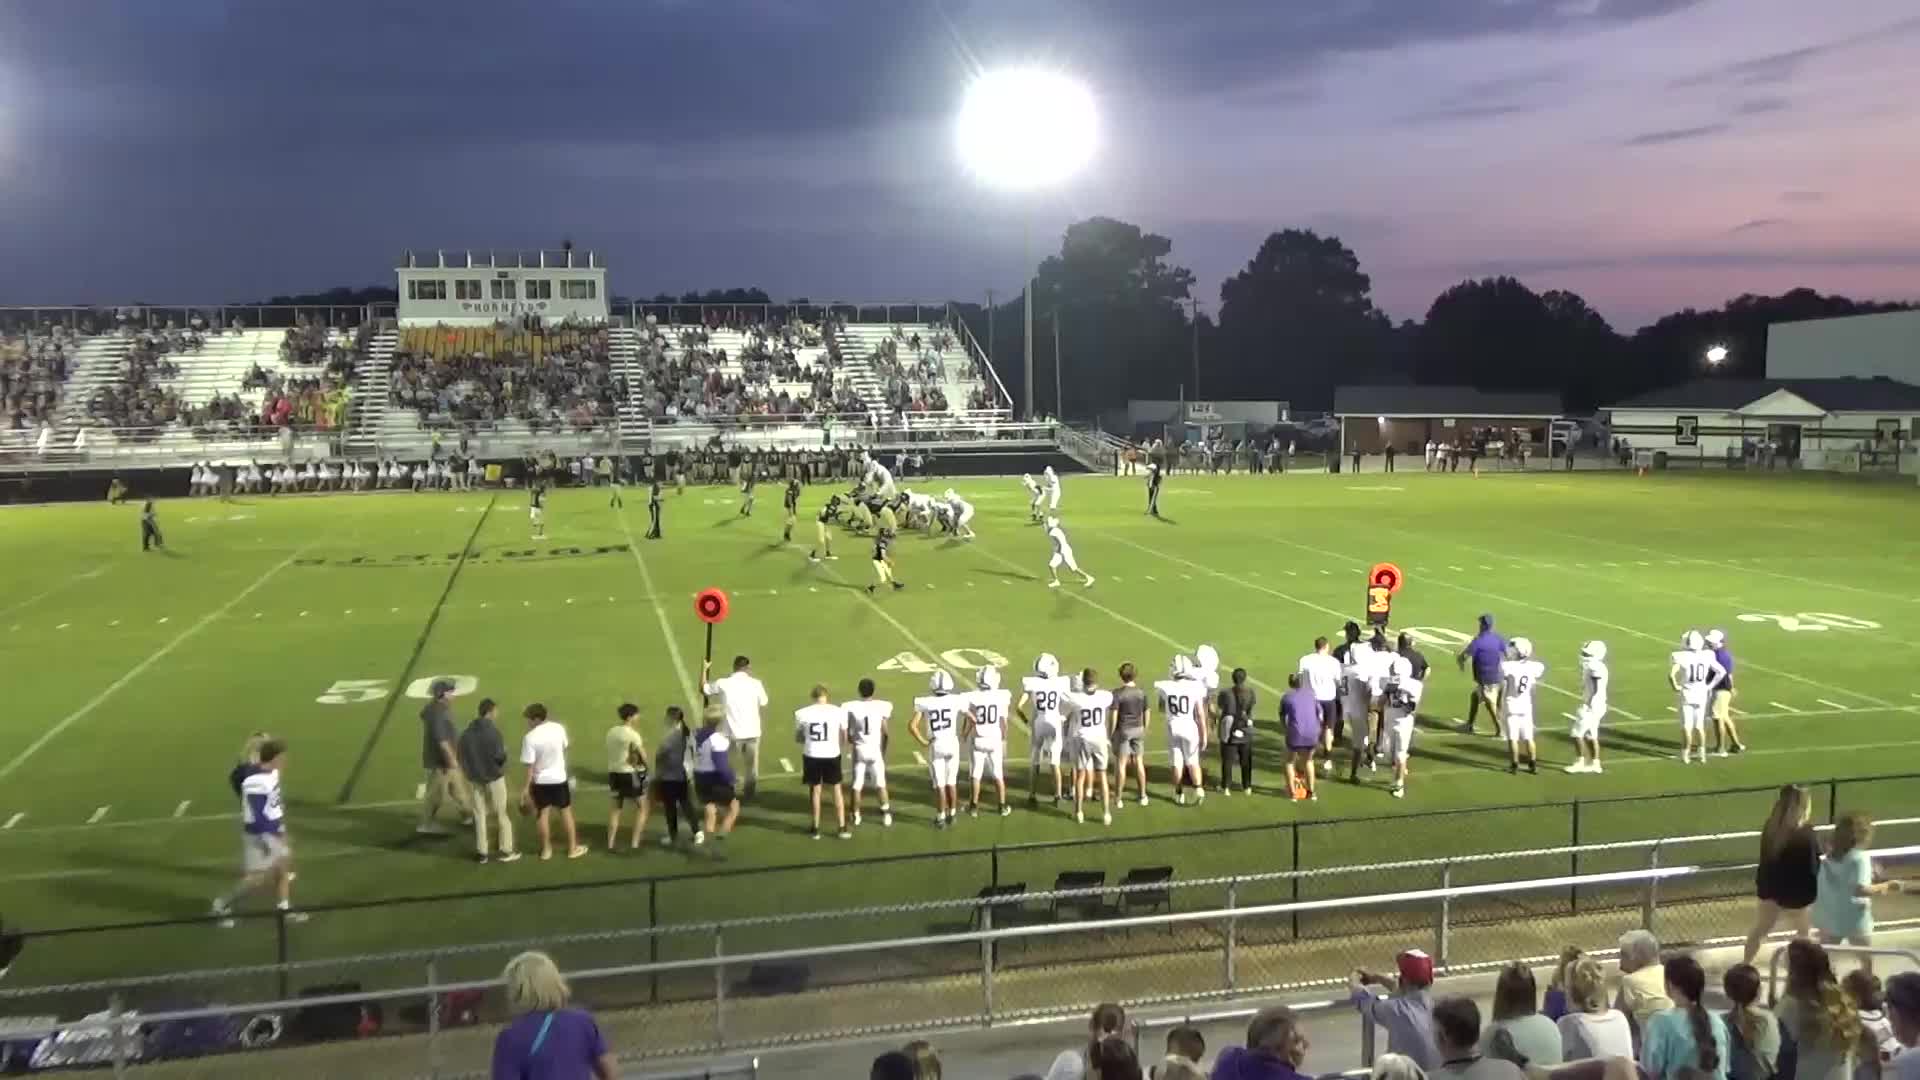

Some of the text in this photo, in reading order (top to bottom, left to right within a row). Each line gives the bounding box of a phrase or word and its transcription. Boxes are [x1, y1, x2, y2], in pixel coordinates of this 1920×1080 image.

[877, 648, 1010, 673] 40
[1688, 662, 1704, 683] 10
[316, 674, 479, 705] 50
[1036, 690, 1058, 711] 28
[1168, 694, 1190, 715] 60
[929, 708, 952, 732] 25
[976, 704, 998, 725] 30
[1081, 707, 1103, 727] 20
[809, 722, 829, 742] 51
[863, 716, 870, 736] 1
